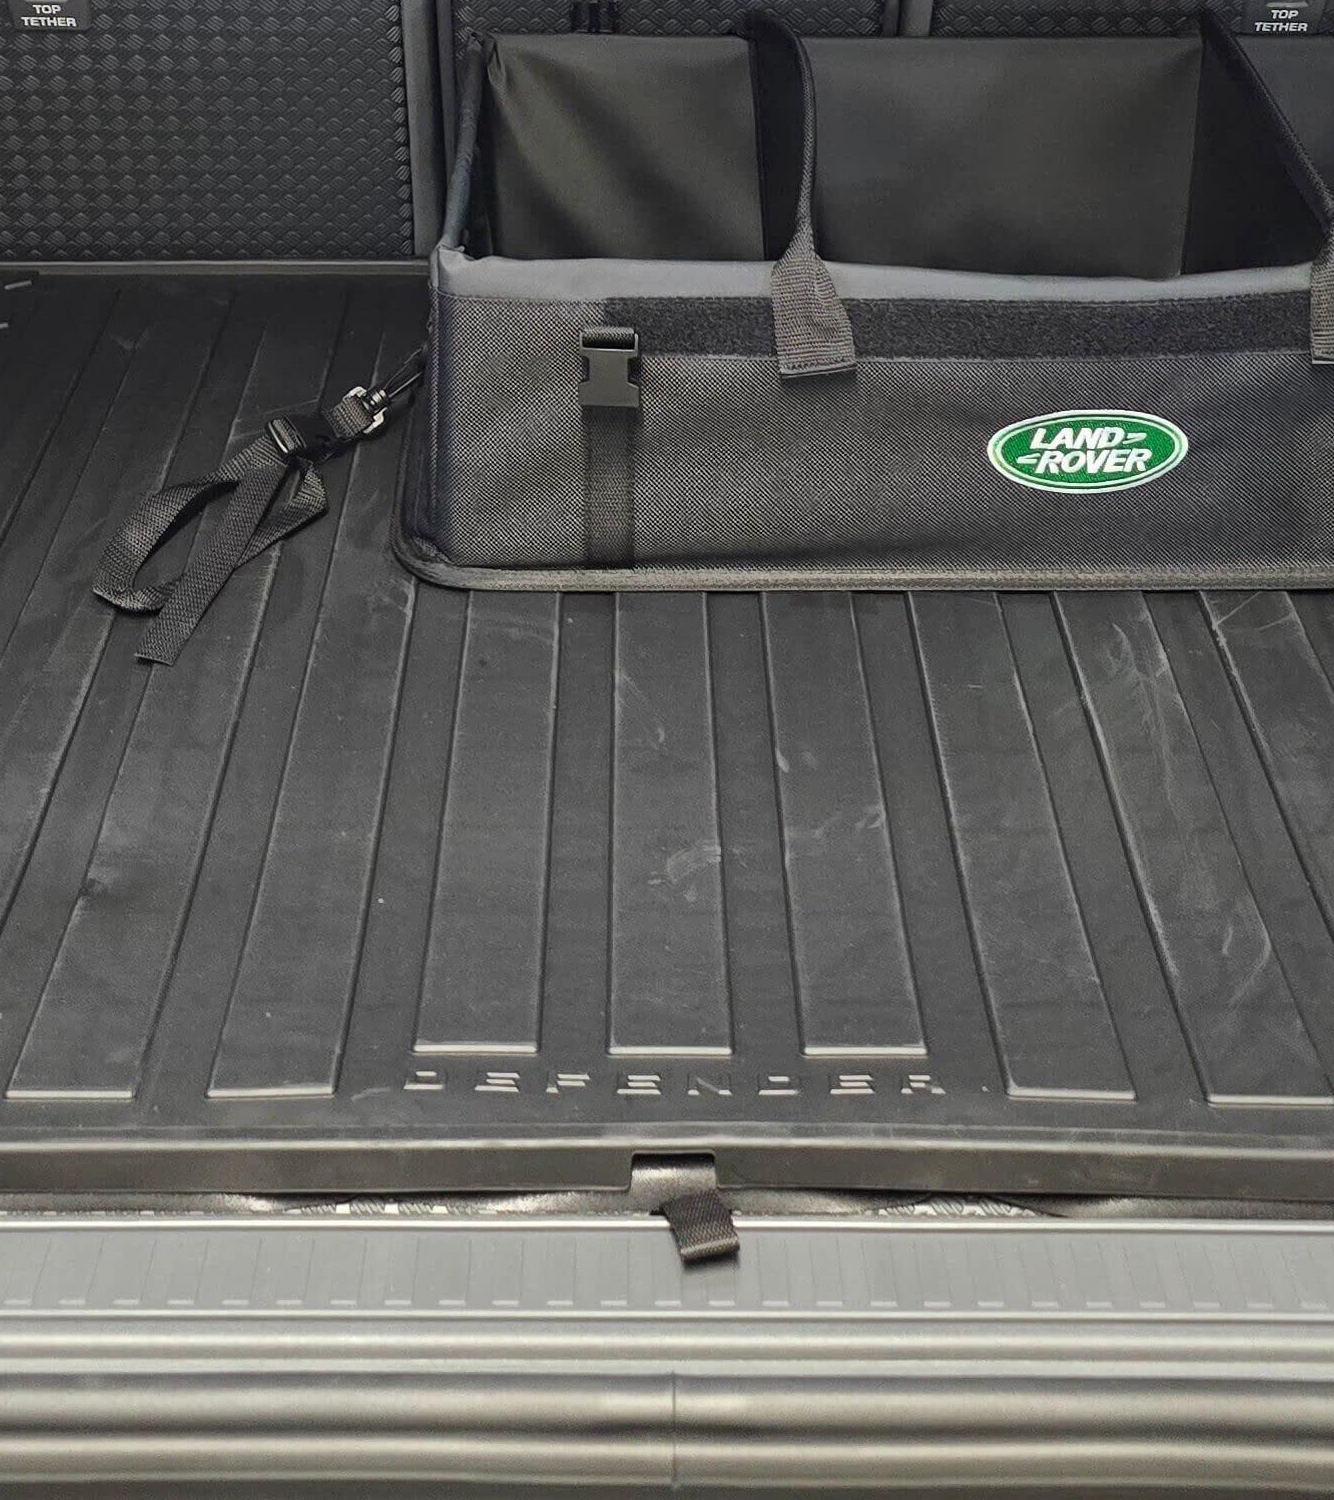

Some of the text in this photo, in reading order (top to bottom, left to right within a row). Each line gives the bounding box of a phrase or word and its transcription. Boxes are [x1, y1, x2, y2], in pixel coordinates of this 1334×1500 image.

[32, 4, 62, 15] TOP
[1270, 9, 1299, 20] TOP
[20, 16, 77, 27] TETHER
[1254, 21, 1309, 32] TETHER
[1029, 426, 1125, 450] LAND
[1034, 449, 1153, 474] ROVER
